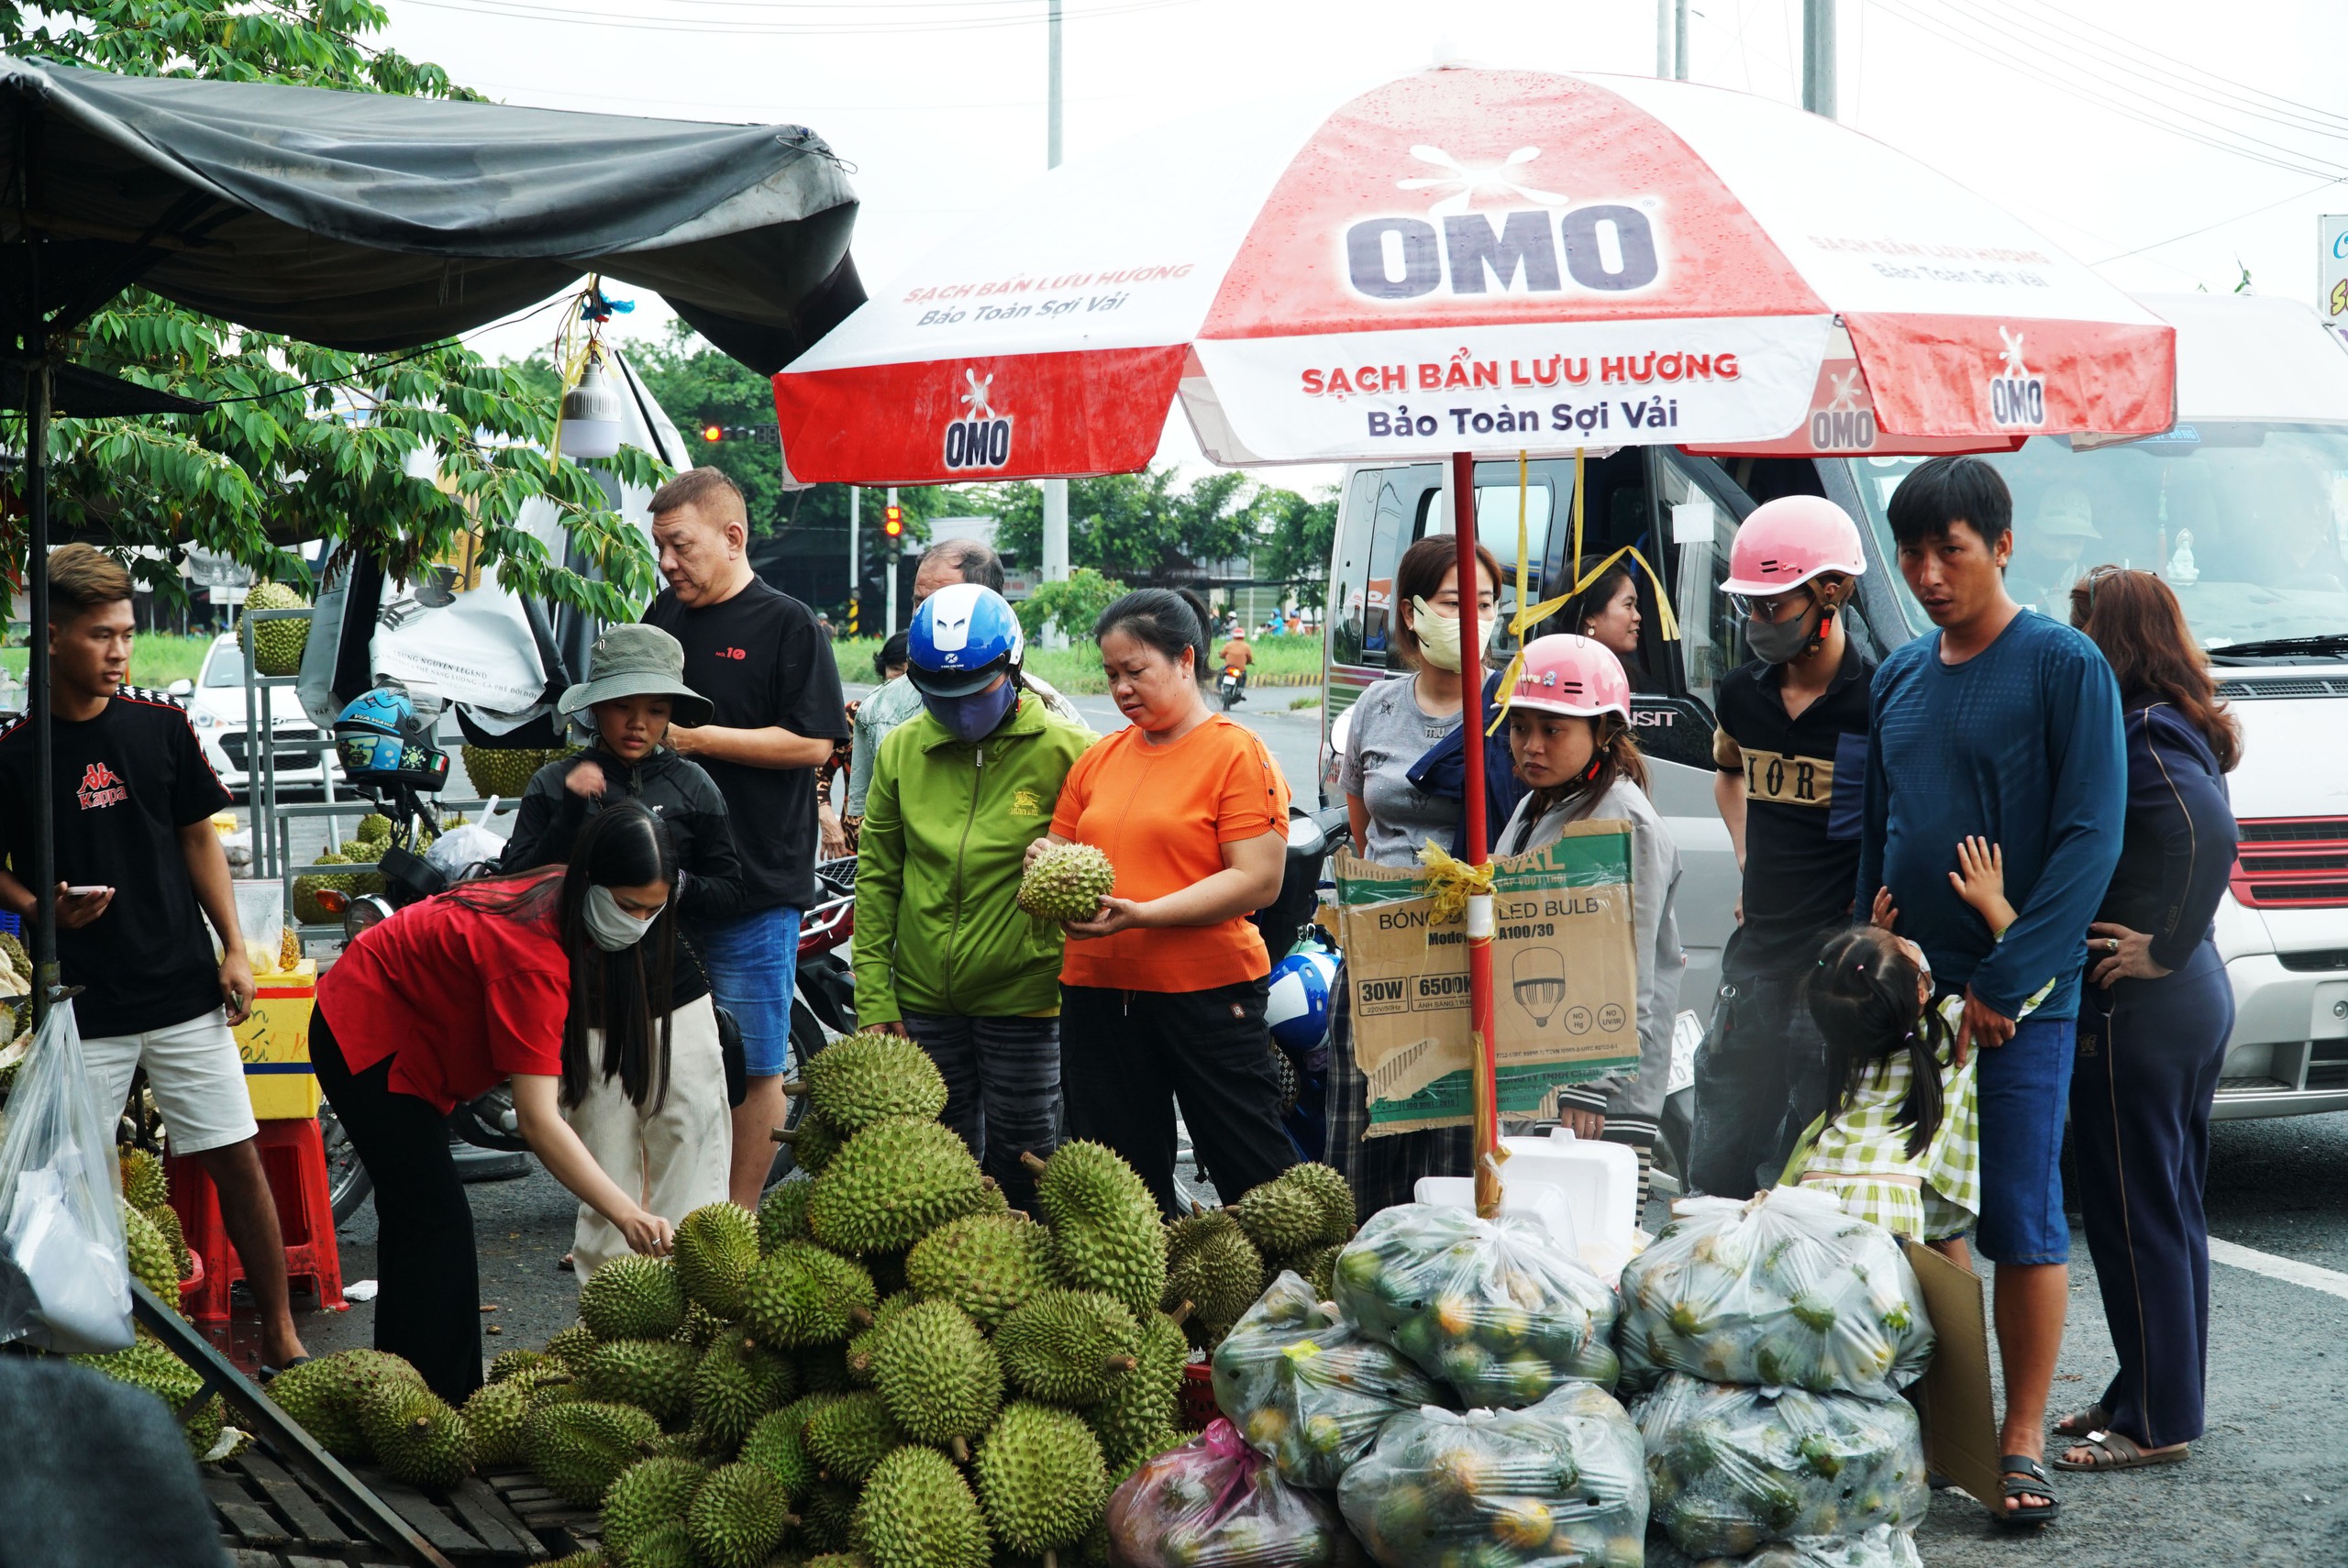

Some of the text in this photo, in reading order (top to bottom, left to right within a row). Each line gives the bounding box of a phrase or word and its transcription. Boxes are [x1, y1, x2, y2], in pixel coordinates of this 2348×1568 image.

[1346, 204, 1658, 299] OMO
[903, 282, 973, 304] SẠCH
[1095, 264, 1194, 285] HƯƠNG
[916, 305, 966, 326] Bảo
[1036, 297, 1082, 322] Sợi
[1086, 292, 1130, 313] Vải
[1301, 346, 1741, 401] SẠCH BẨN LƯU HƯƠNG
[1368, 395, 1678, 438] Bảo Toàn Sợi Vải
[1992, 379, 2043, 425] OMO
[947, 420, 1009, 467] OMO
[1812, 410, 1874, 449] OMO
[456, 666, 488, 679] LEGEND
[78, 786, 127, 810] Kappa
[1545, 897, 1599, 917] BULB
[1499, 922, 1555, 940] A100/30
[1362, 981, 1403, 1001] 30W
